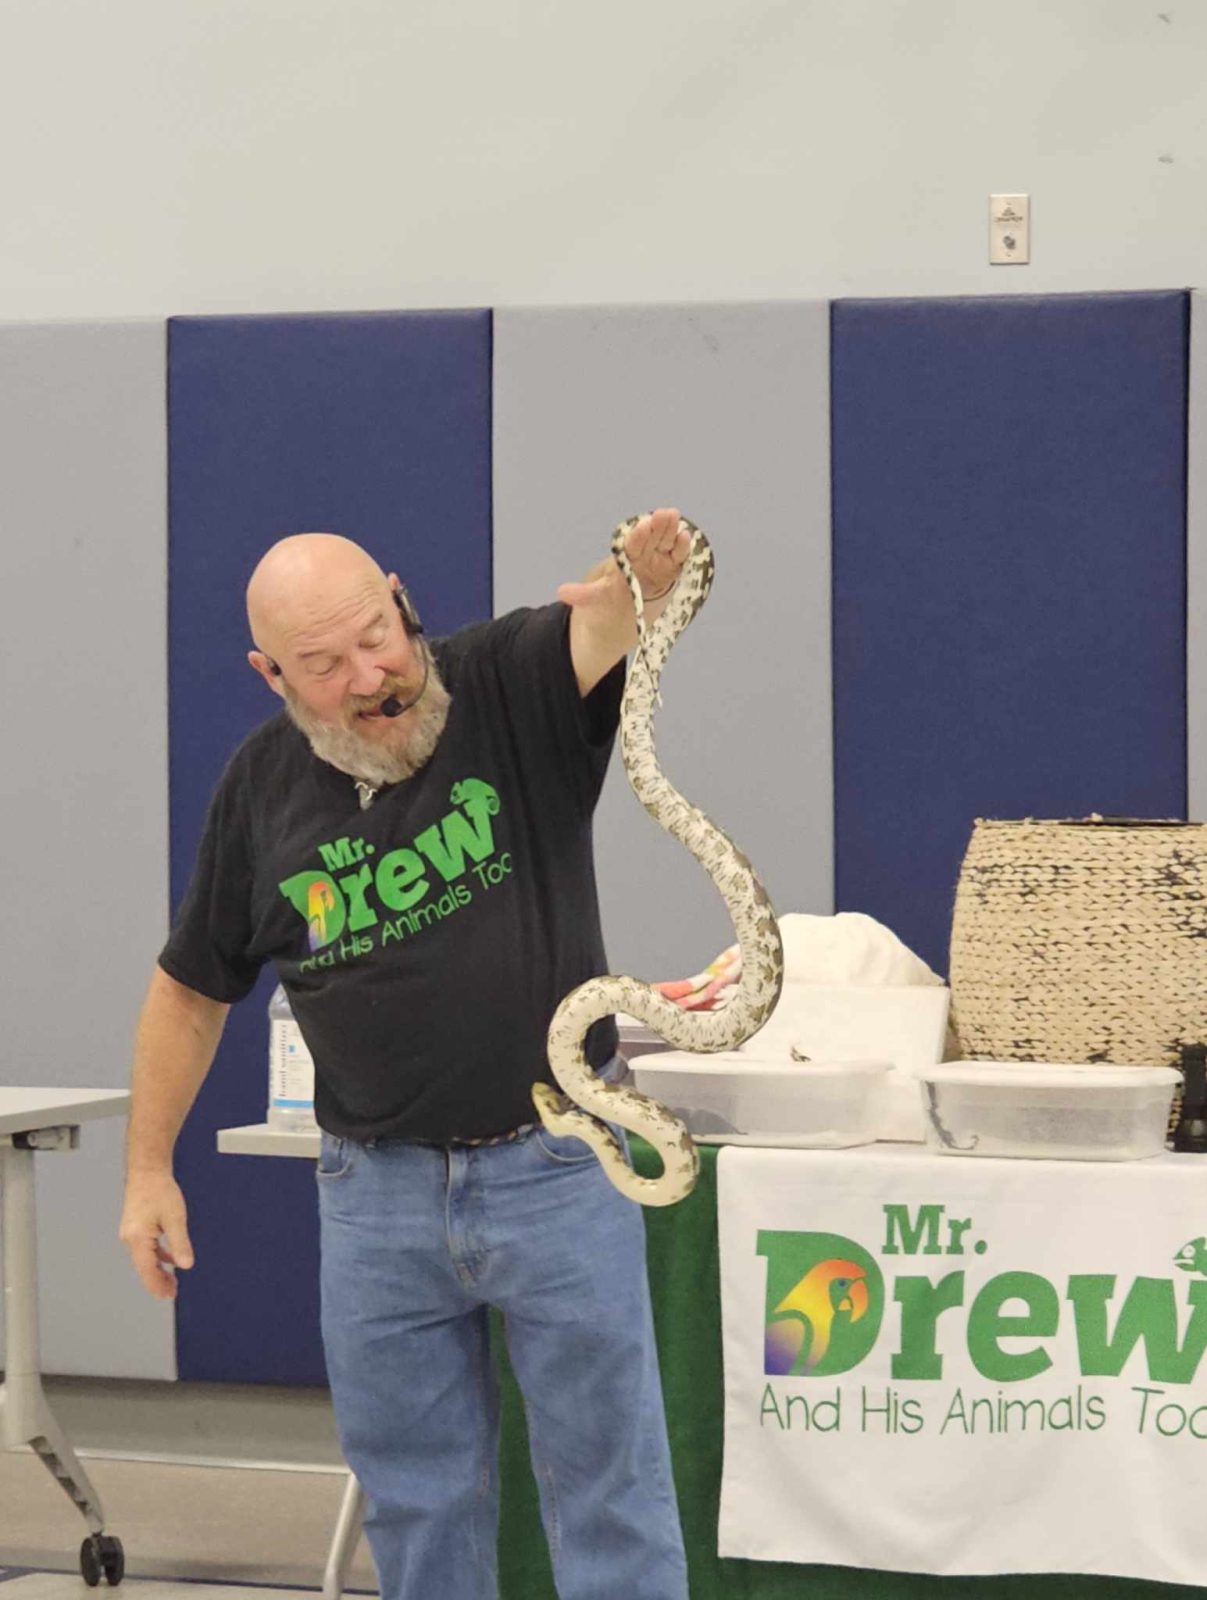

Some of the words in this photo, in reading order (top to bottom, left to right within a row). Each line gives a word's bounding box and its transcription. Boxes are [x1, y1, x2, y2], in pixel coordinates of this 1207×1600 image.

[278, 798, 496, 952] Drew
[318, 836, 375, 872] Mr.
[339, 934, 374, 961] His
[381, 884, 472, 948] Animals
[882, 1204, 988, 1255] Mr.
[756, 1229, 1207, 1385] Drew
[760, 1383, 841, 1434] And
[861, 1386, 924, 1434] His
[940, 1384, 1106, 1435] Animals
